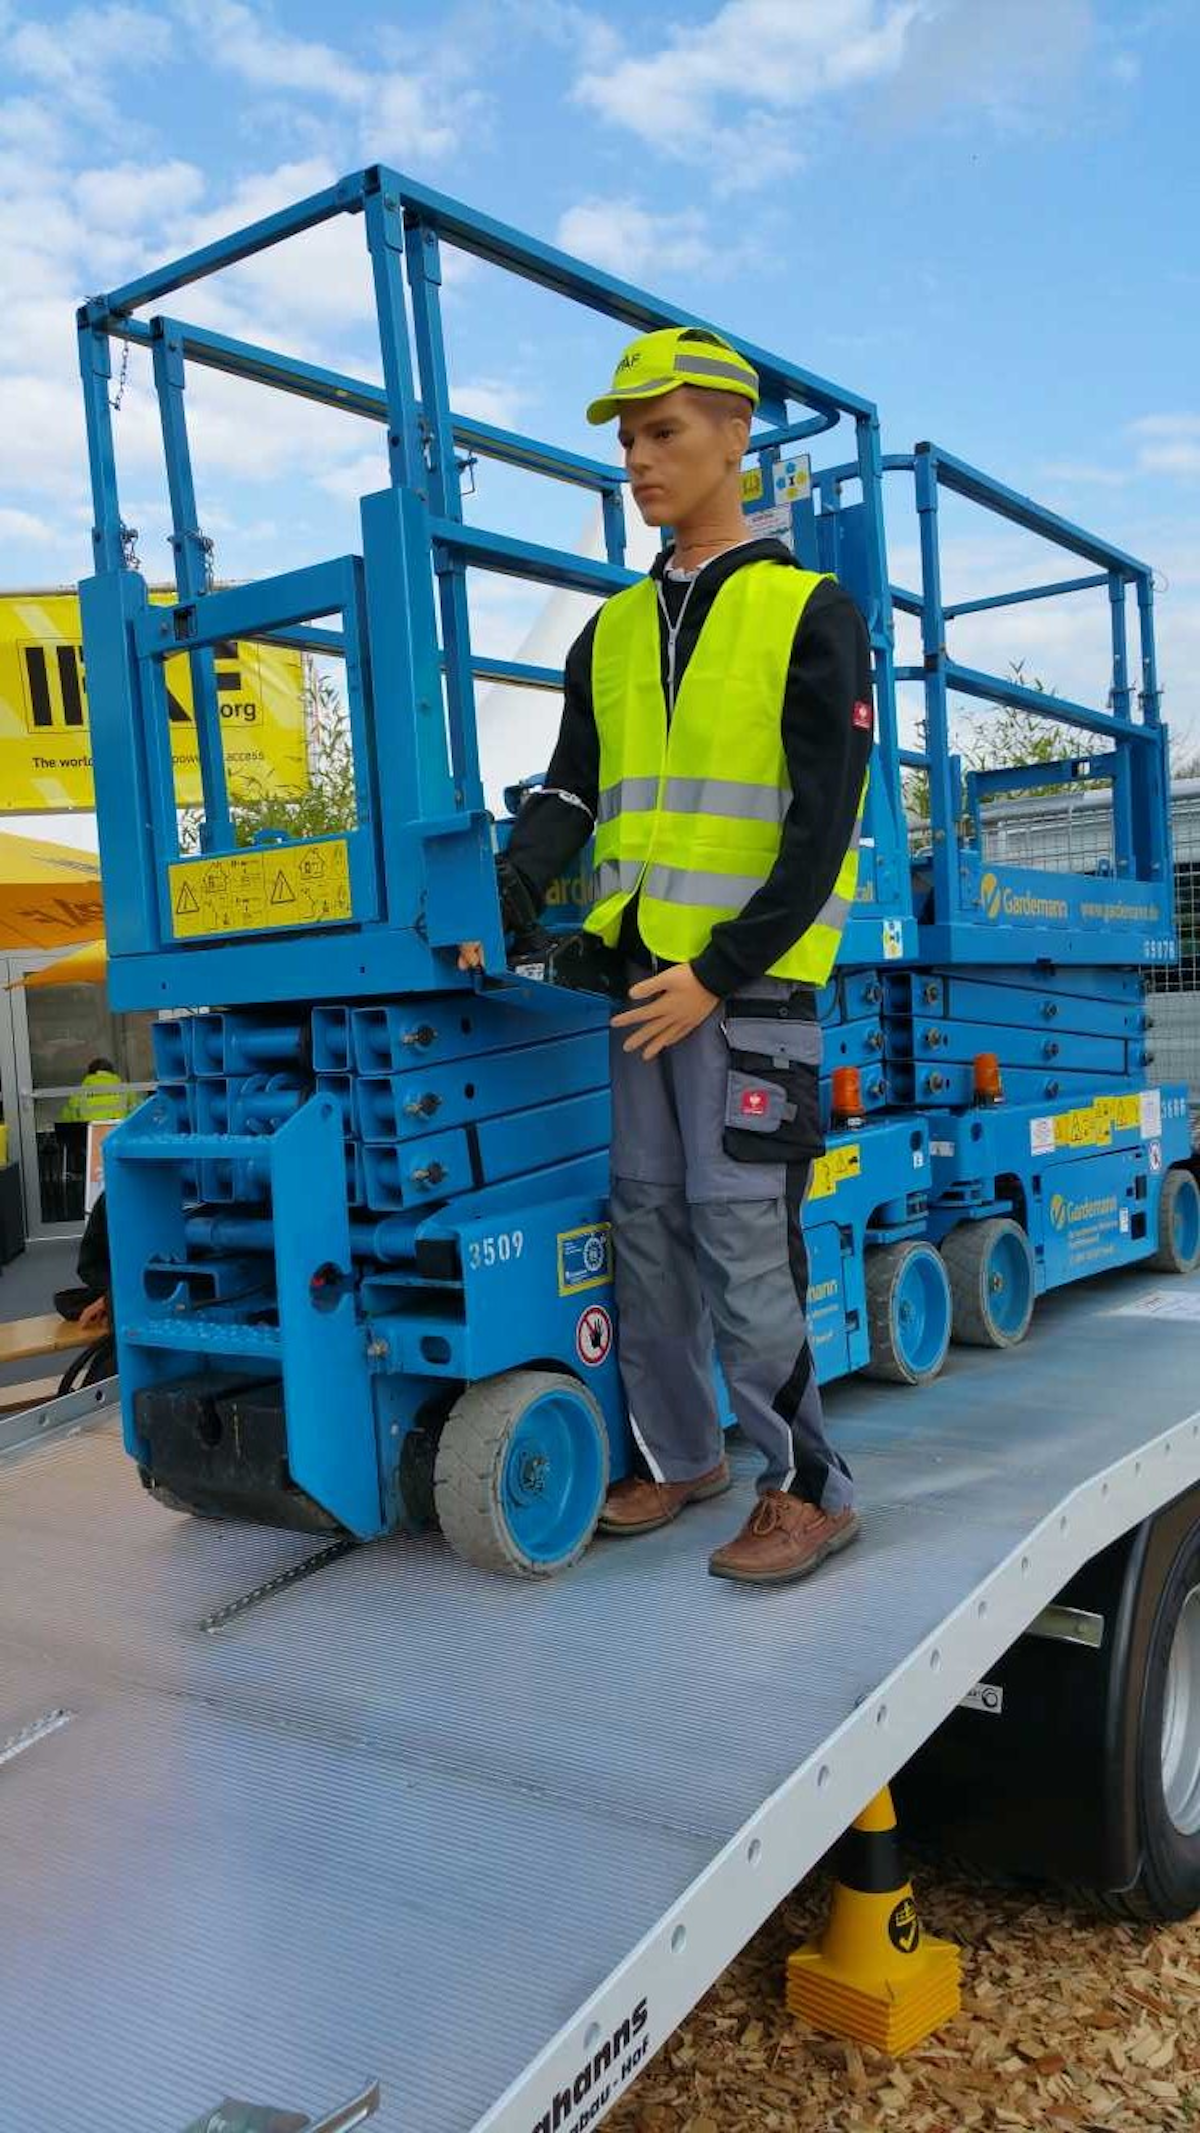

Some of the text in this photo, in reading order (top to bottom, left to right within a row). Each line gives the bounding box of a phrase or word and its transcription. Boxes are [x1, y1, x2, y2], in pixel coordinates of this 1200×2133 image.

[32, 757, 55, 768] The
[1003, 886, 1068, 919] Gardemann
[469, 1230, 524, 1270] 3509
[621, 2032, 649, 2082] Hof
